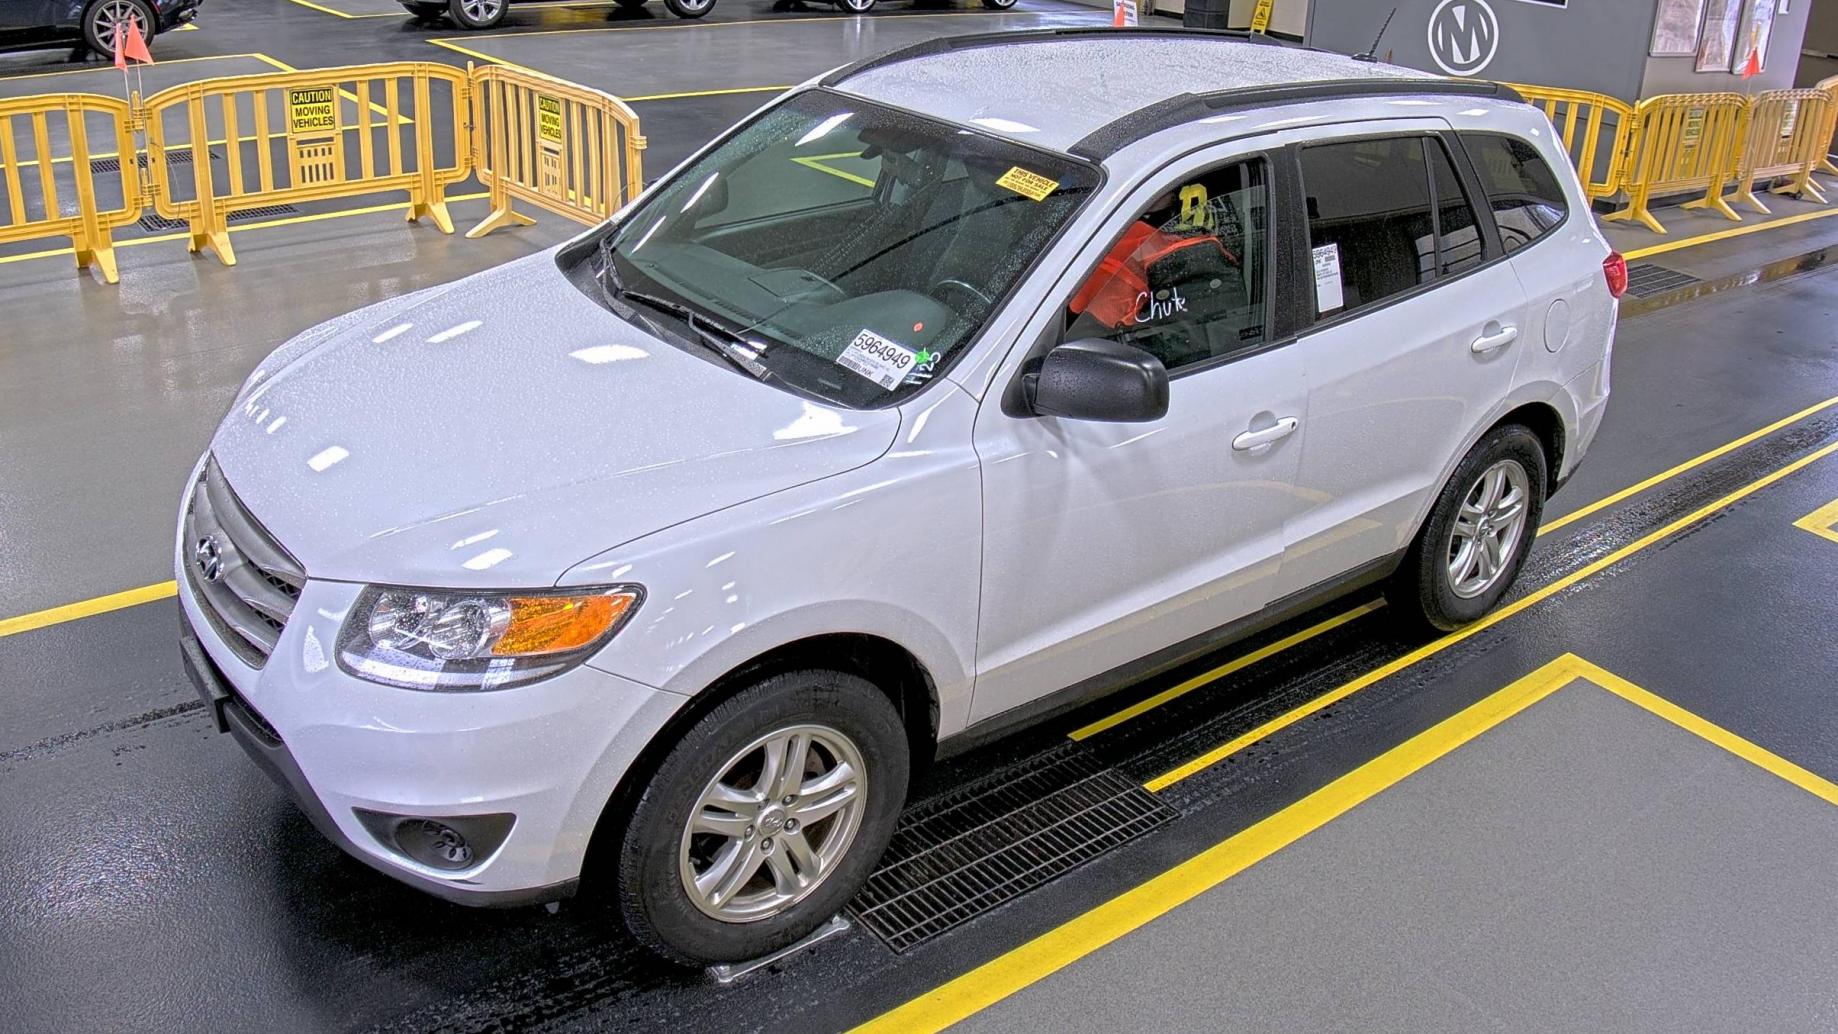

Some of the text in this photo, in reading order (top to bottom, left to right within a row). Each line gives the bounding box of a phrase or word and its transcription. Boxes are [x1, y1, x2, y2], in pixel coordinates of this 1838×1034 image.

[1434, 2, 1492, 68] M
[292, 90, 331, 104] CAUTION
[295, 105, 331, 117] MOVING
[293, 116, 334, 128] VEHICLES
[853, 333, 911, 369] 5964949
